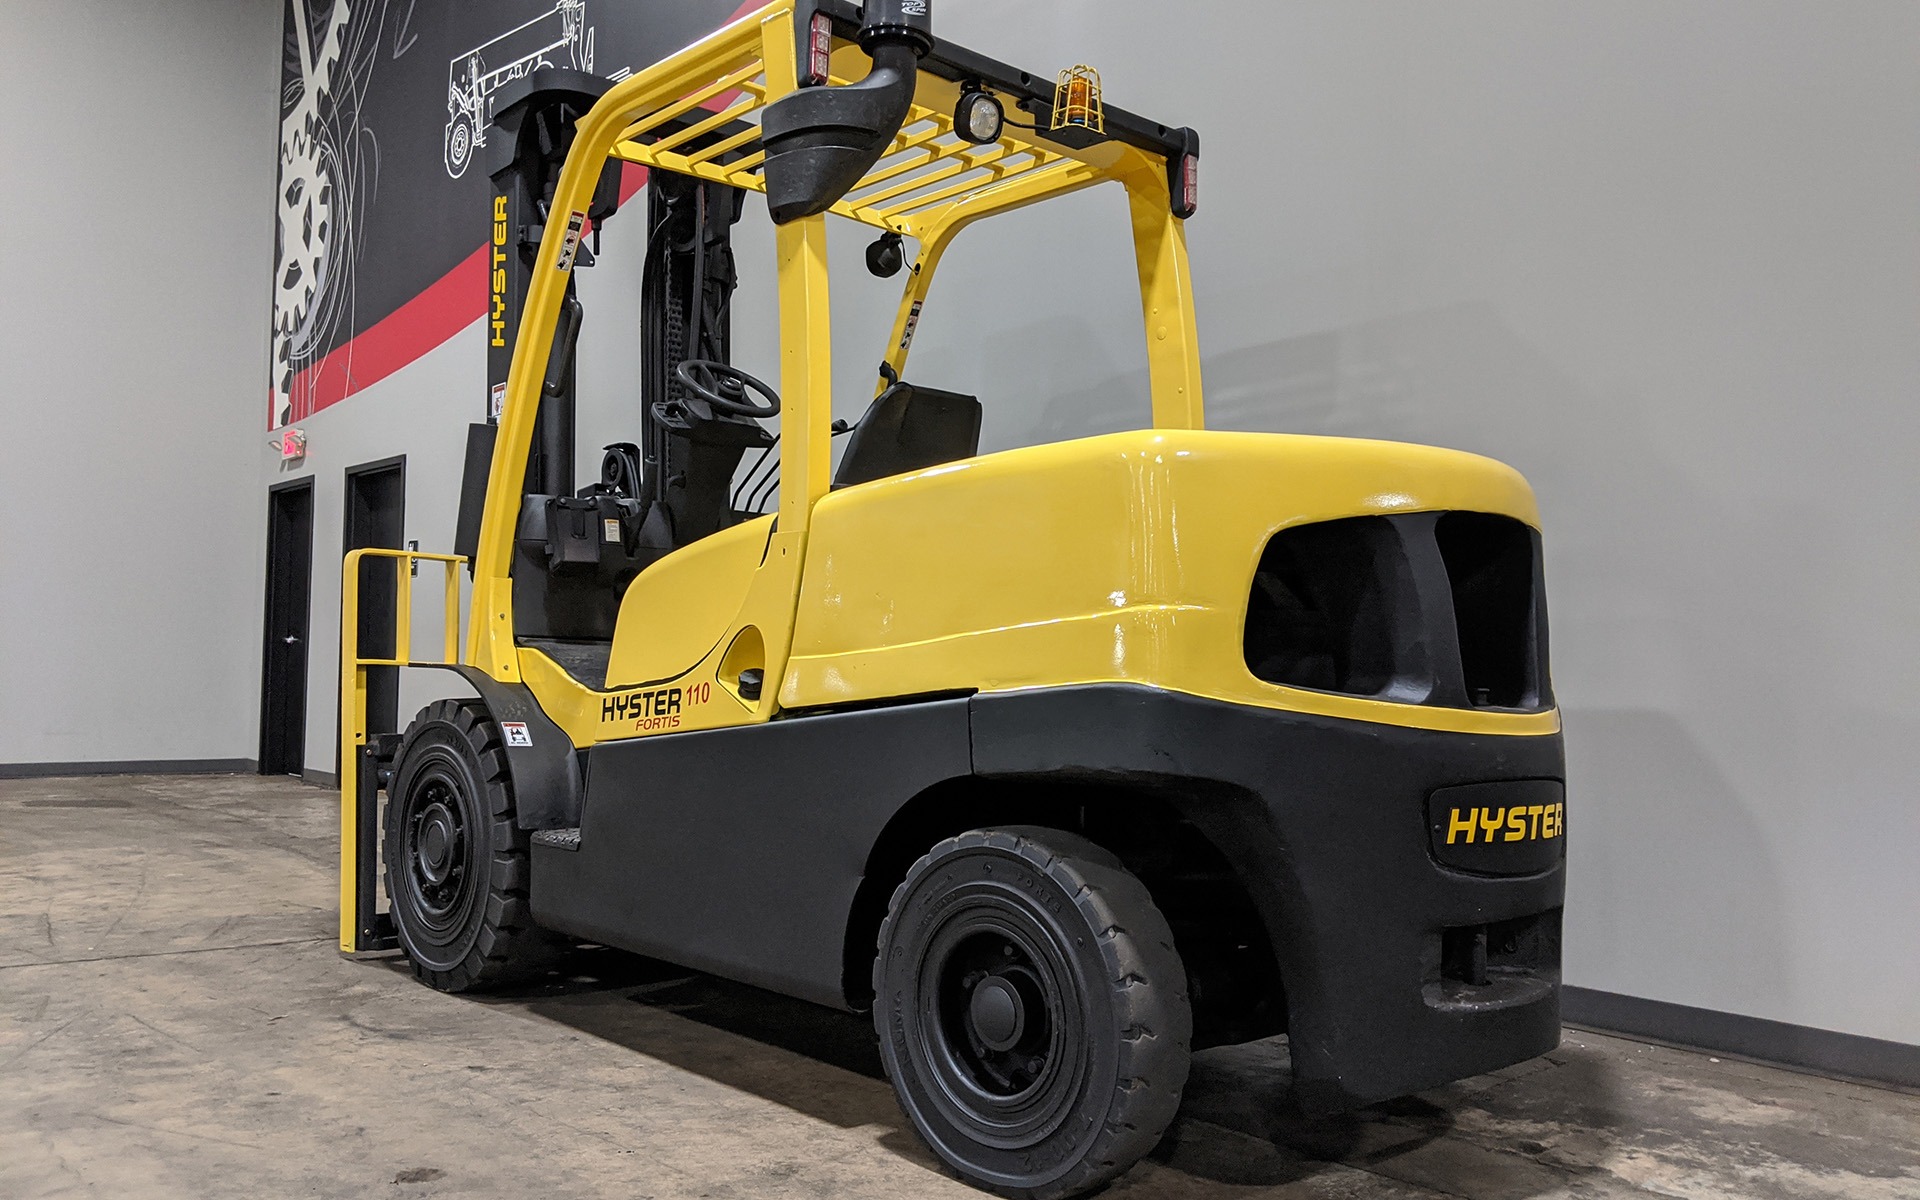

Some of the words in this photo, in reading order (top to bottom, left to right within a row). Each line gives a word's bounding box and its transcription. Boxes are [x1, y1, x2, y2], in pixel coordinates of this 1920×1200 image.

[491, 195, 508, 347] HYSTER
[601, 688, 682, 723] HYSTER
[686, 681, 710, 706] 110
[635, 715, 681, 731] FORTIS
[1446, 802, 1563, 844] HYSTER
